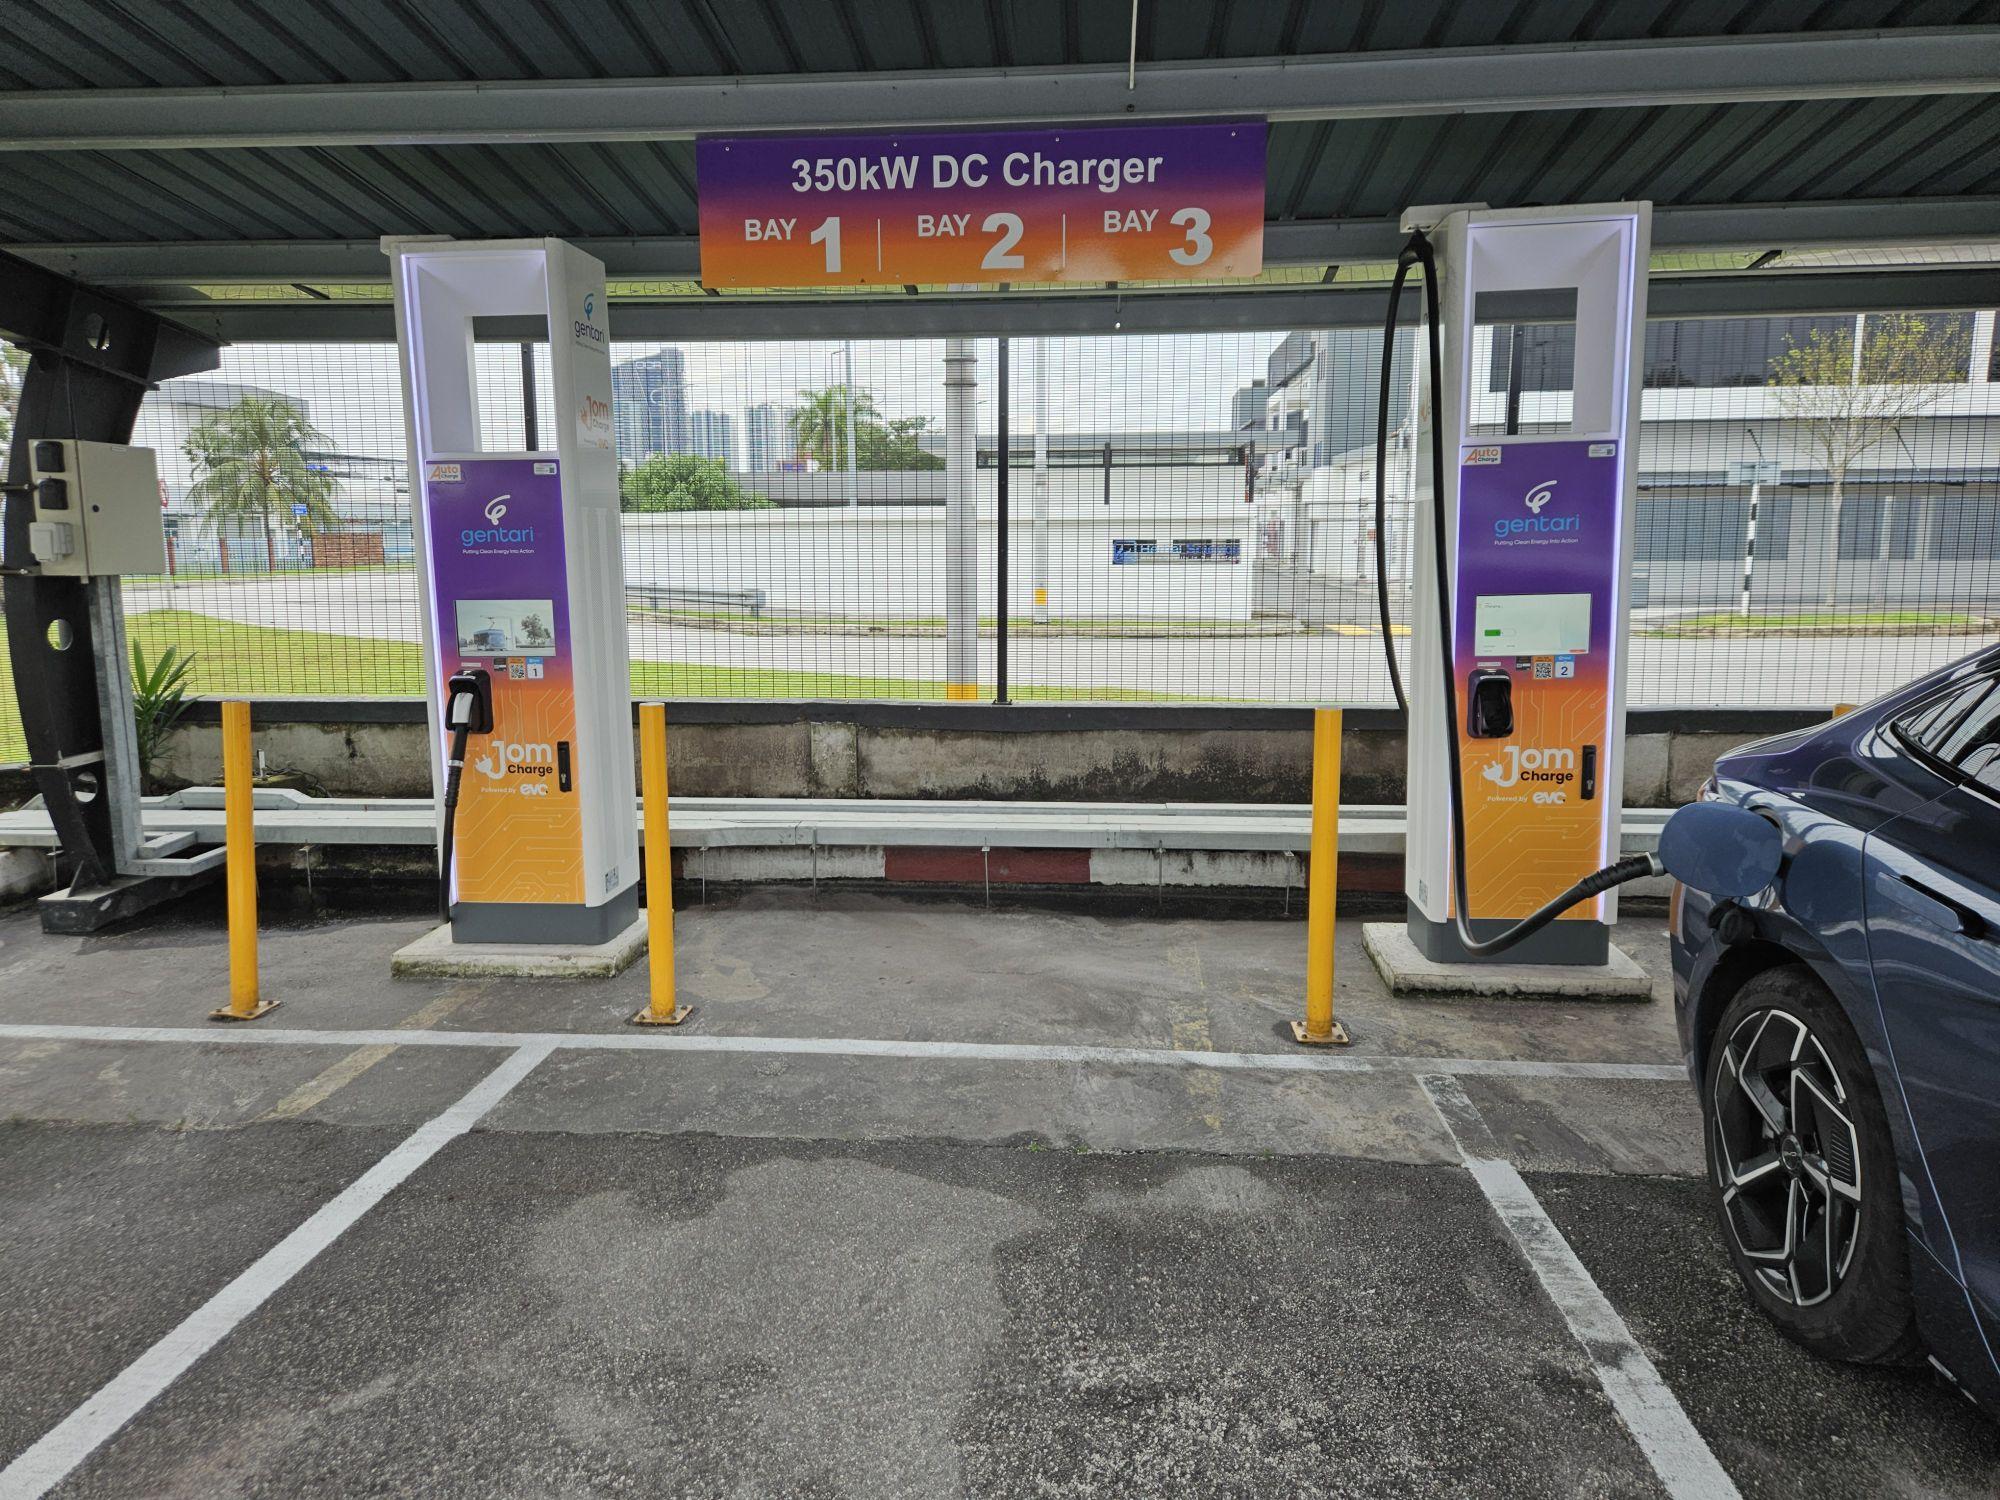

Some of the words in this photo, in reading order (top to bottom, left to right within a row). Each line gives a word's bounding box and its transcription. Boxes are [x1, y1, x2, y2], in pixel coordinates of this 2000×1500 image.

[791, 155, 919, 193] 350kW
[933, 153, 989, 188] DC
[1002, 152, 1164, 193] Charger
[744, 217, 797, 241] BAY
[810, 216, 843, 273] 1
[917, 213, 971, 237] BAY
[980, 212, 1025, 270] 2
[1103, 209, 1160, 233] BAY
[1168, 207, 1214, 267] 3
[574, 320, 605, 344] gentari
[1464, 448, 1499, 464] Auto
[429, 464, 459, 480] Auto
[461, 526, 535, 547] gentari
[1494, 514, 1580, 538] gentari
[533, 668, 538, 677] 1
[1561, 666, 1568, 676] 2
[485, 741, 553, 779] Jom
[507, 764, 553, 777] Charge
[1494, 745, 1574, 787] Jom
[1520, 771, 1574, 784] Charge
